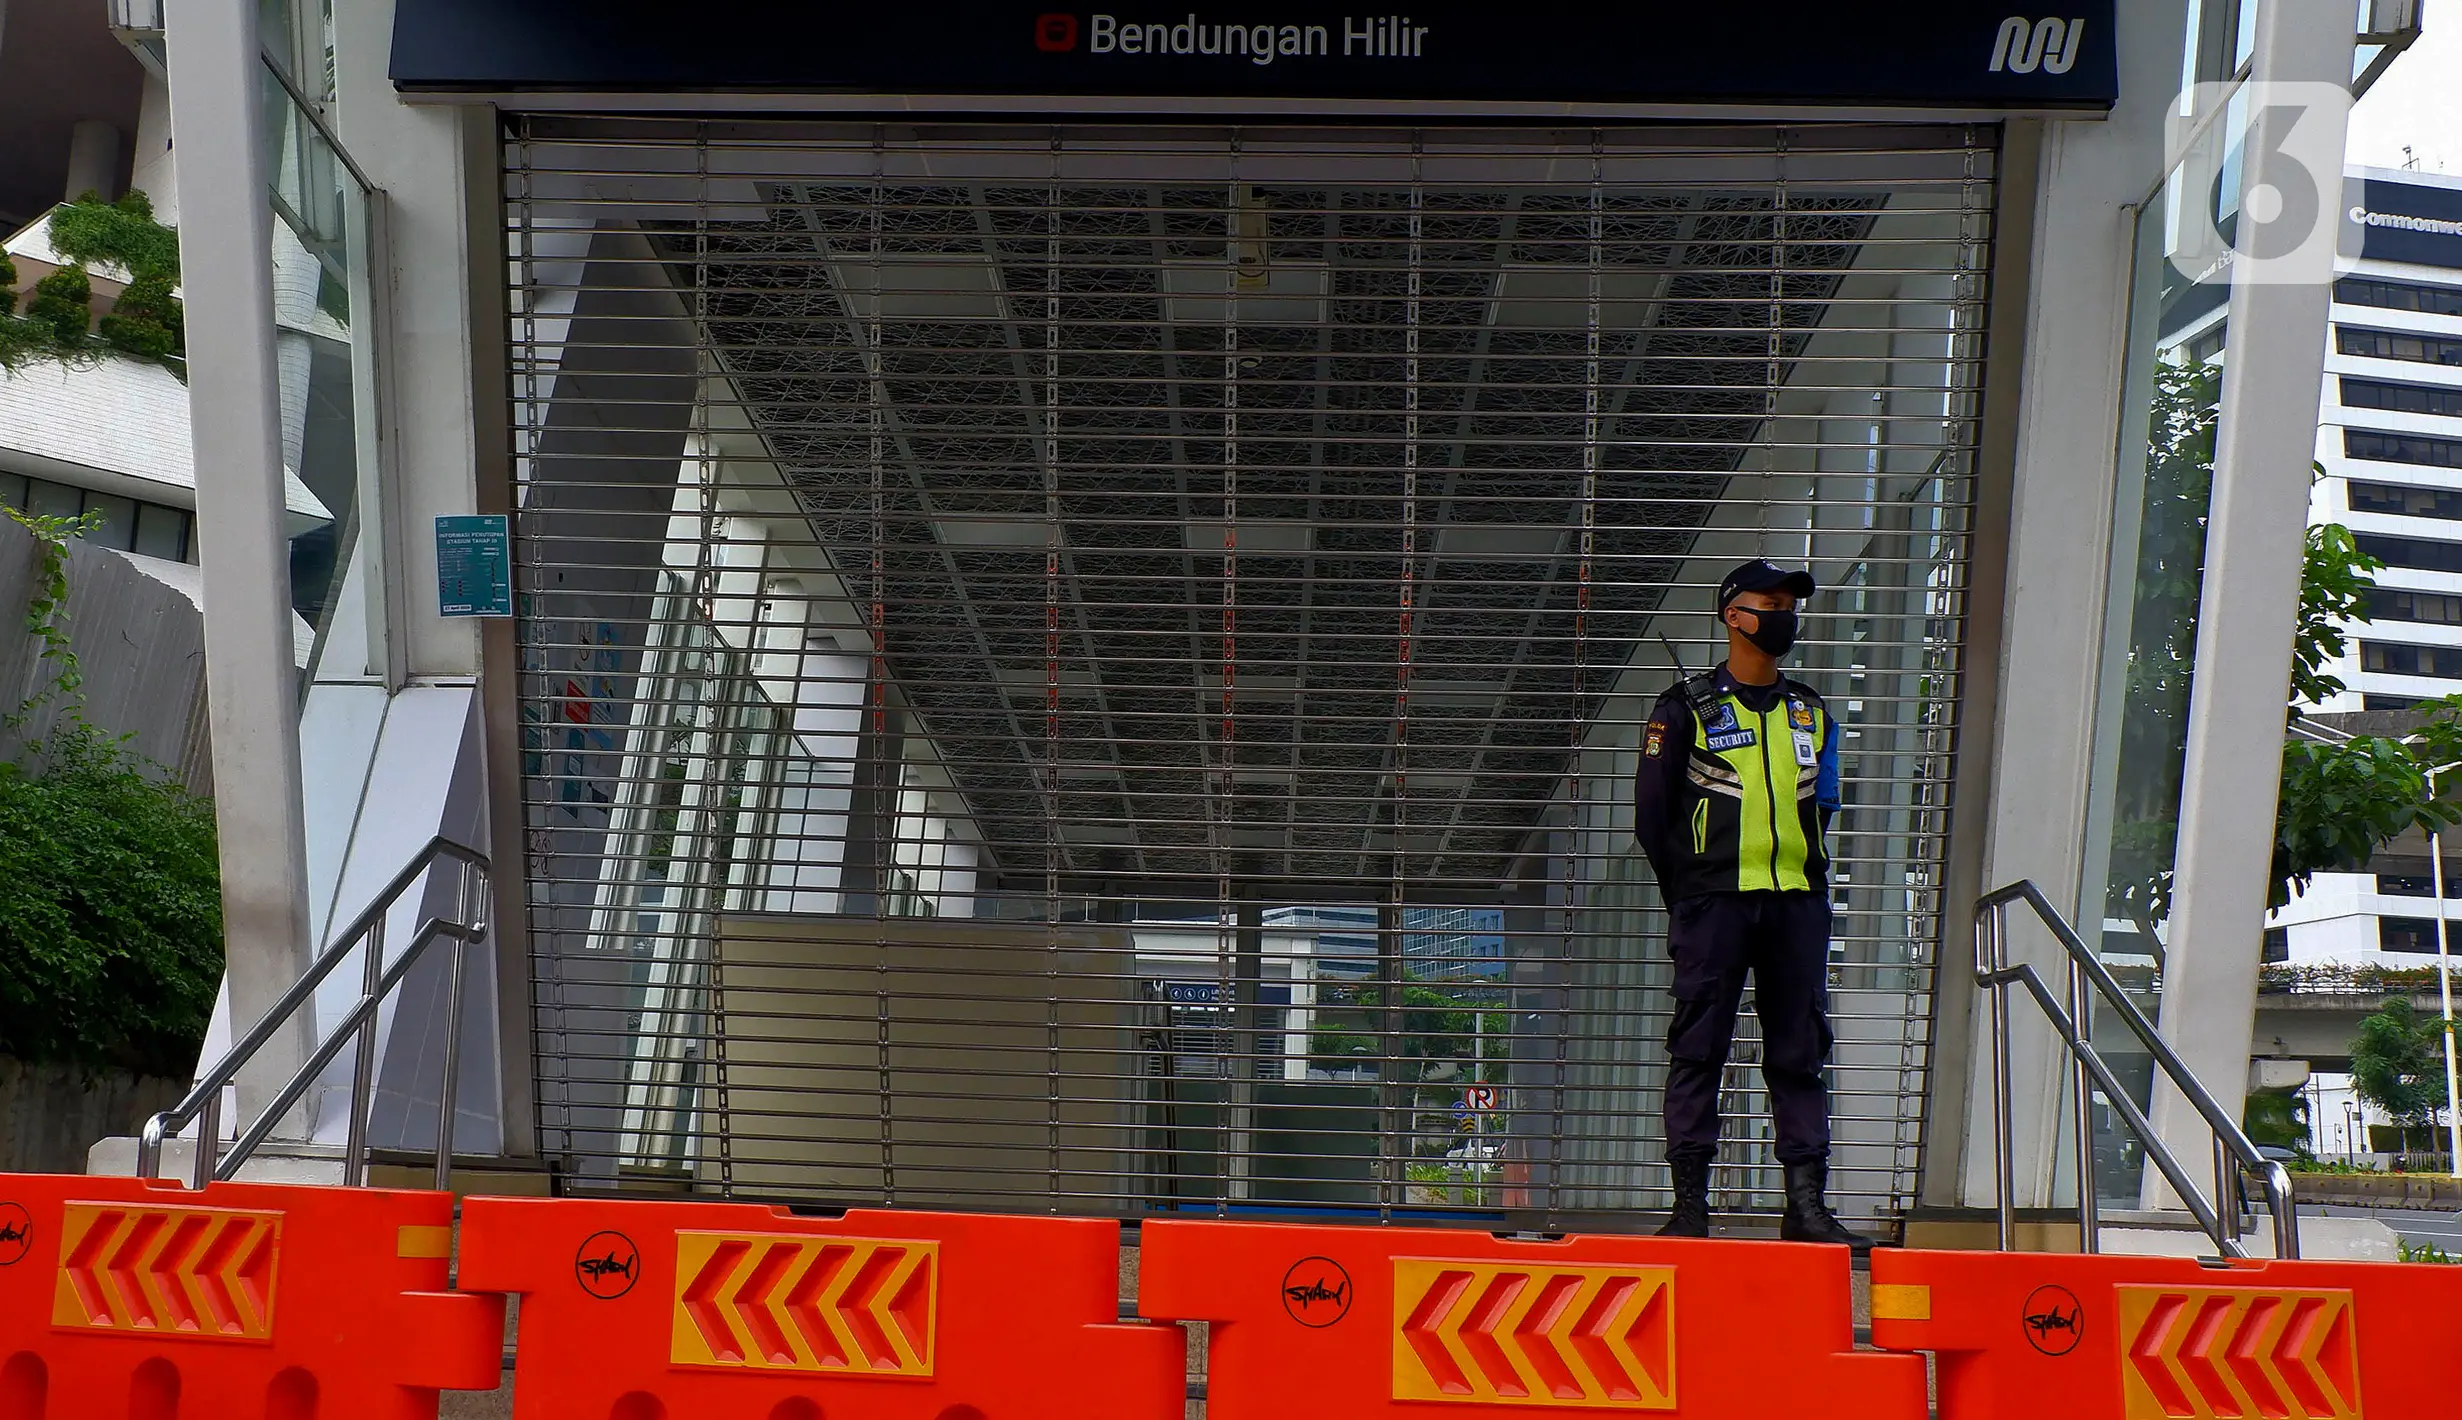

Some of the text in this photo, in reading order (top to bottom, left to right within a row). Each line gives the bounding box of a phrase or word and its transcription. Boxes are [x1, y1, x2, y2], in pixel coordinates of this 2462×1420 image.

[1090, 13, 1429, 66] Bendungan Hilir
[1708, 731, 1753, 749] SECURITY
